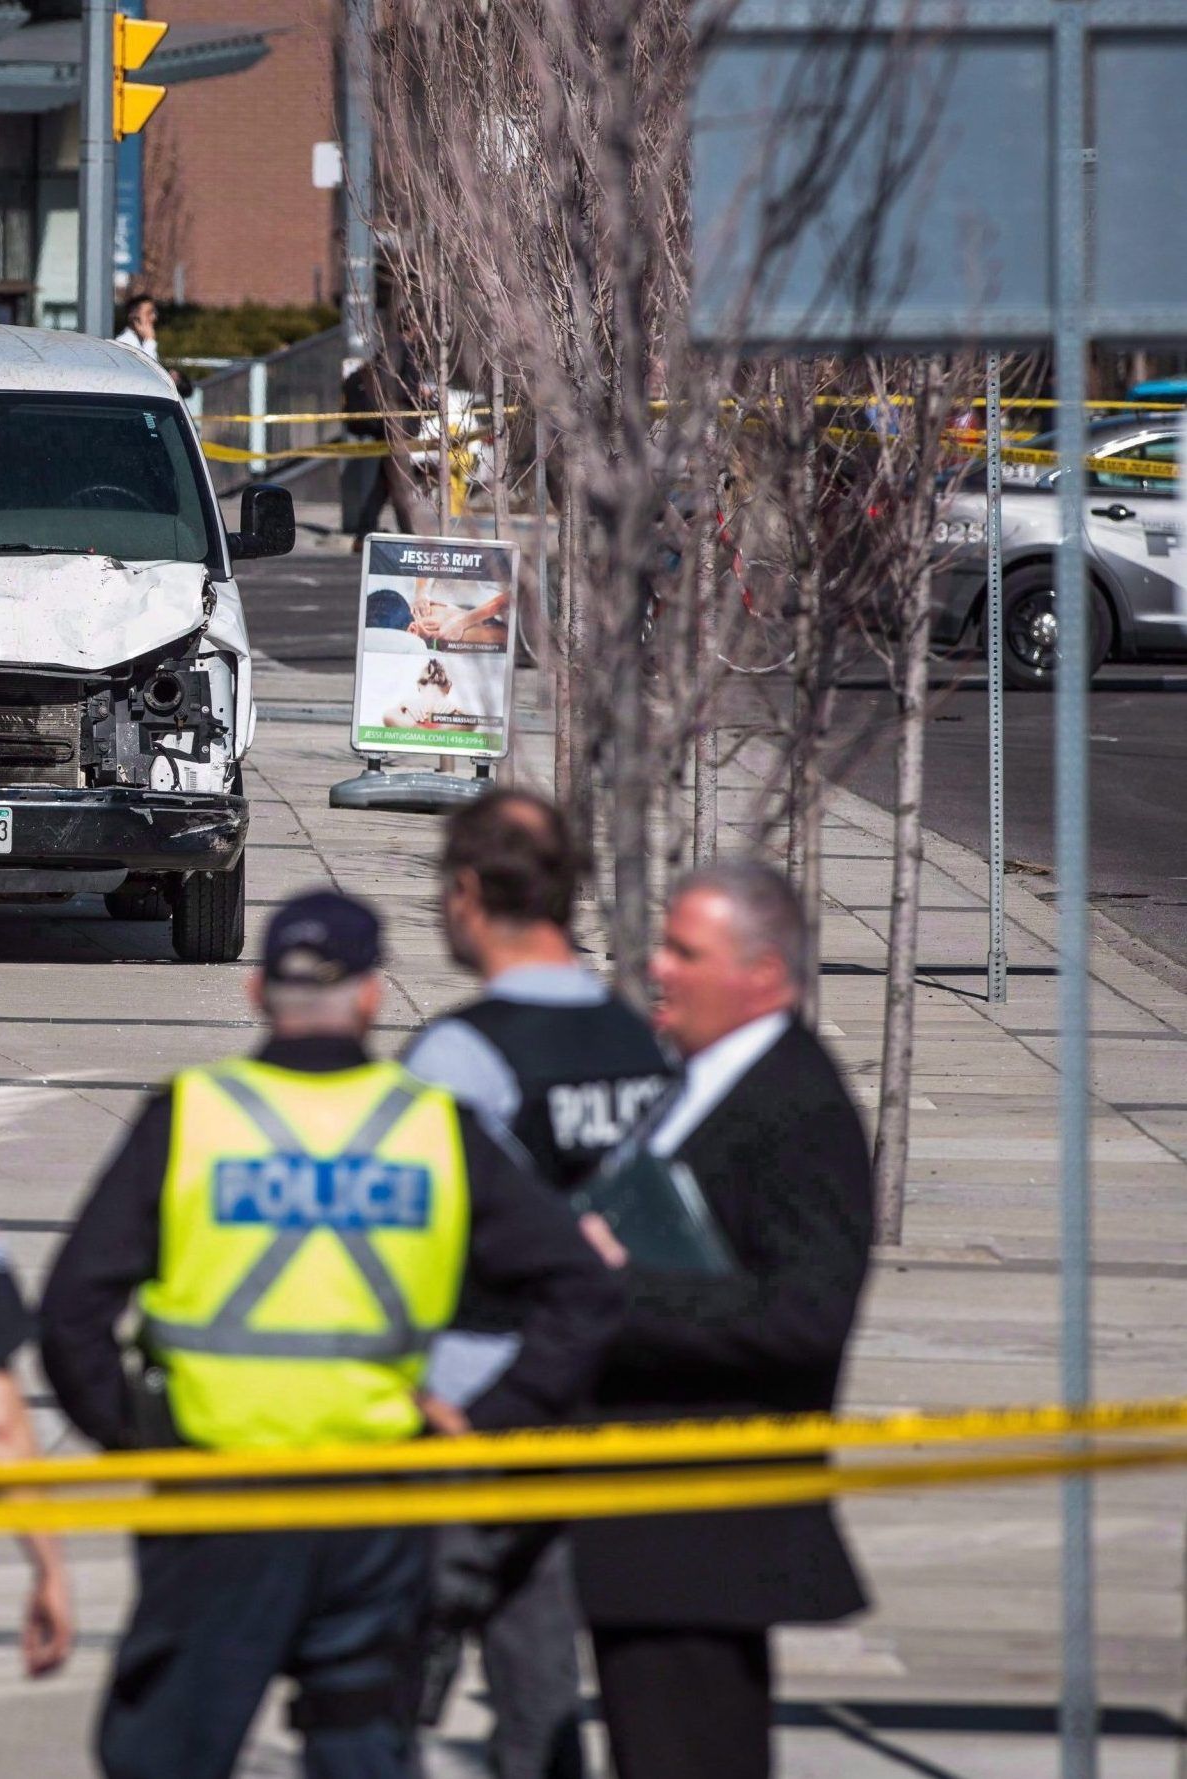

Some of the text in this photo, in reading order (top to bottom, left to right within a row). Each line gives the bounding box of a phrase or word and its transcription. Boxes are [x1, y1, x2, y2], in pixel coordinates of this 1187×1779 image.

[933, 521, 987, 543] 325
[399, 550, 483, 568] JESSE'S RMT
[452, 716, 477, 724] MASSAGE
[217, 1161, 424, 1223] POLICE
